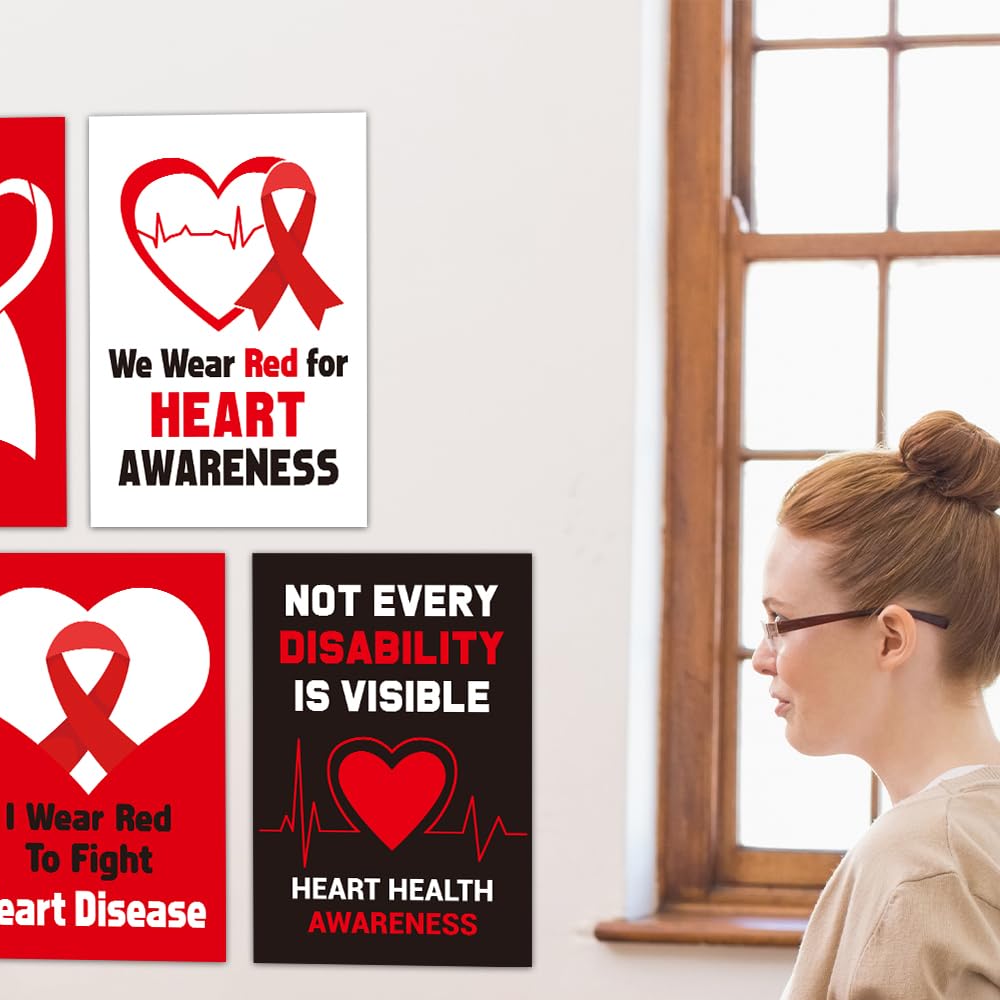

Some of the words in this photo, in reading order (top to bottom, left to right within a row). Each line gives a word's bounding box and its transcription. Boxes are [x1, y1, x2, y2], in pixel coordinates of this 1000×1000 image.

[109, 349, 152, 378] We
[161, 349, 235, 377] Wear
[245, 348, 297, 377] Red
[307, 348, 348, 377] for
[151, 392, 305, 437] HEART
[119, 448, 338, 486] AWARENESS
[286, 585, 361, 616] NOT
[374, 585, 498, 616] EVERY
[280, 630, 503, 664] DISABILITY
[295, 680, 329, 711] IS
[341, 680, 489, 712] VISIBLE
[6, 803, 14, 830] I
[26, 803, 104, 831] Wear
[116, 804, 171, 832] Red
[25, 842, 60, 872] To
[72, 843, 152, 880] Fight
[293, 877, 380, 900] HEART
[389, 879, 492, 901] HEALTH
[75, 891, 206, 928] Disease
[308, 912, 477, 936] AWARENESS
